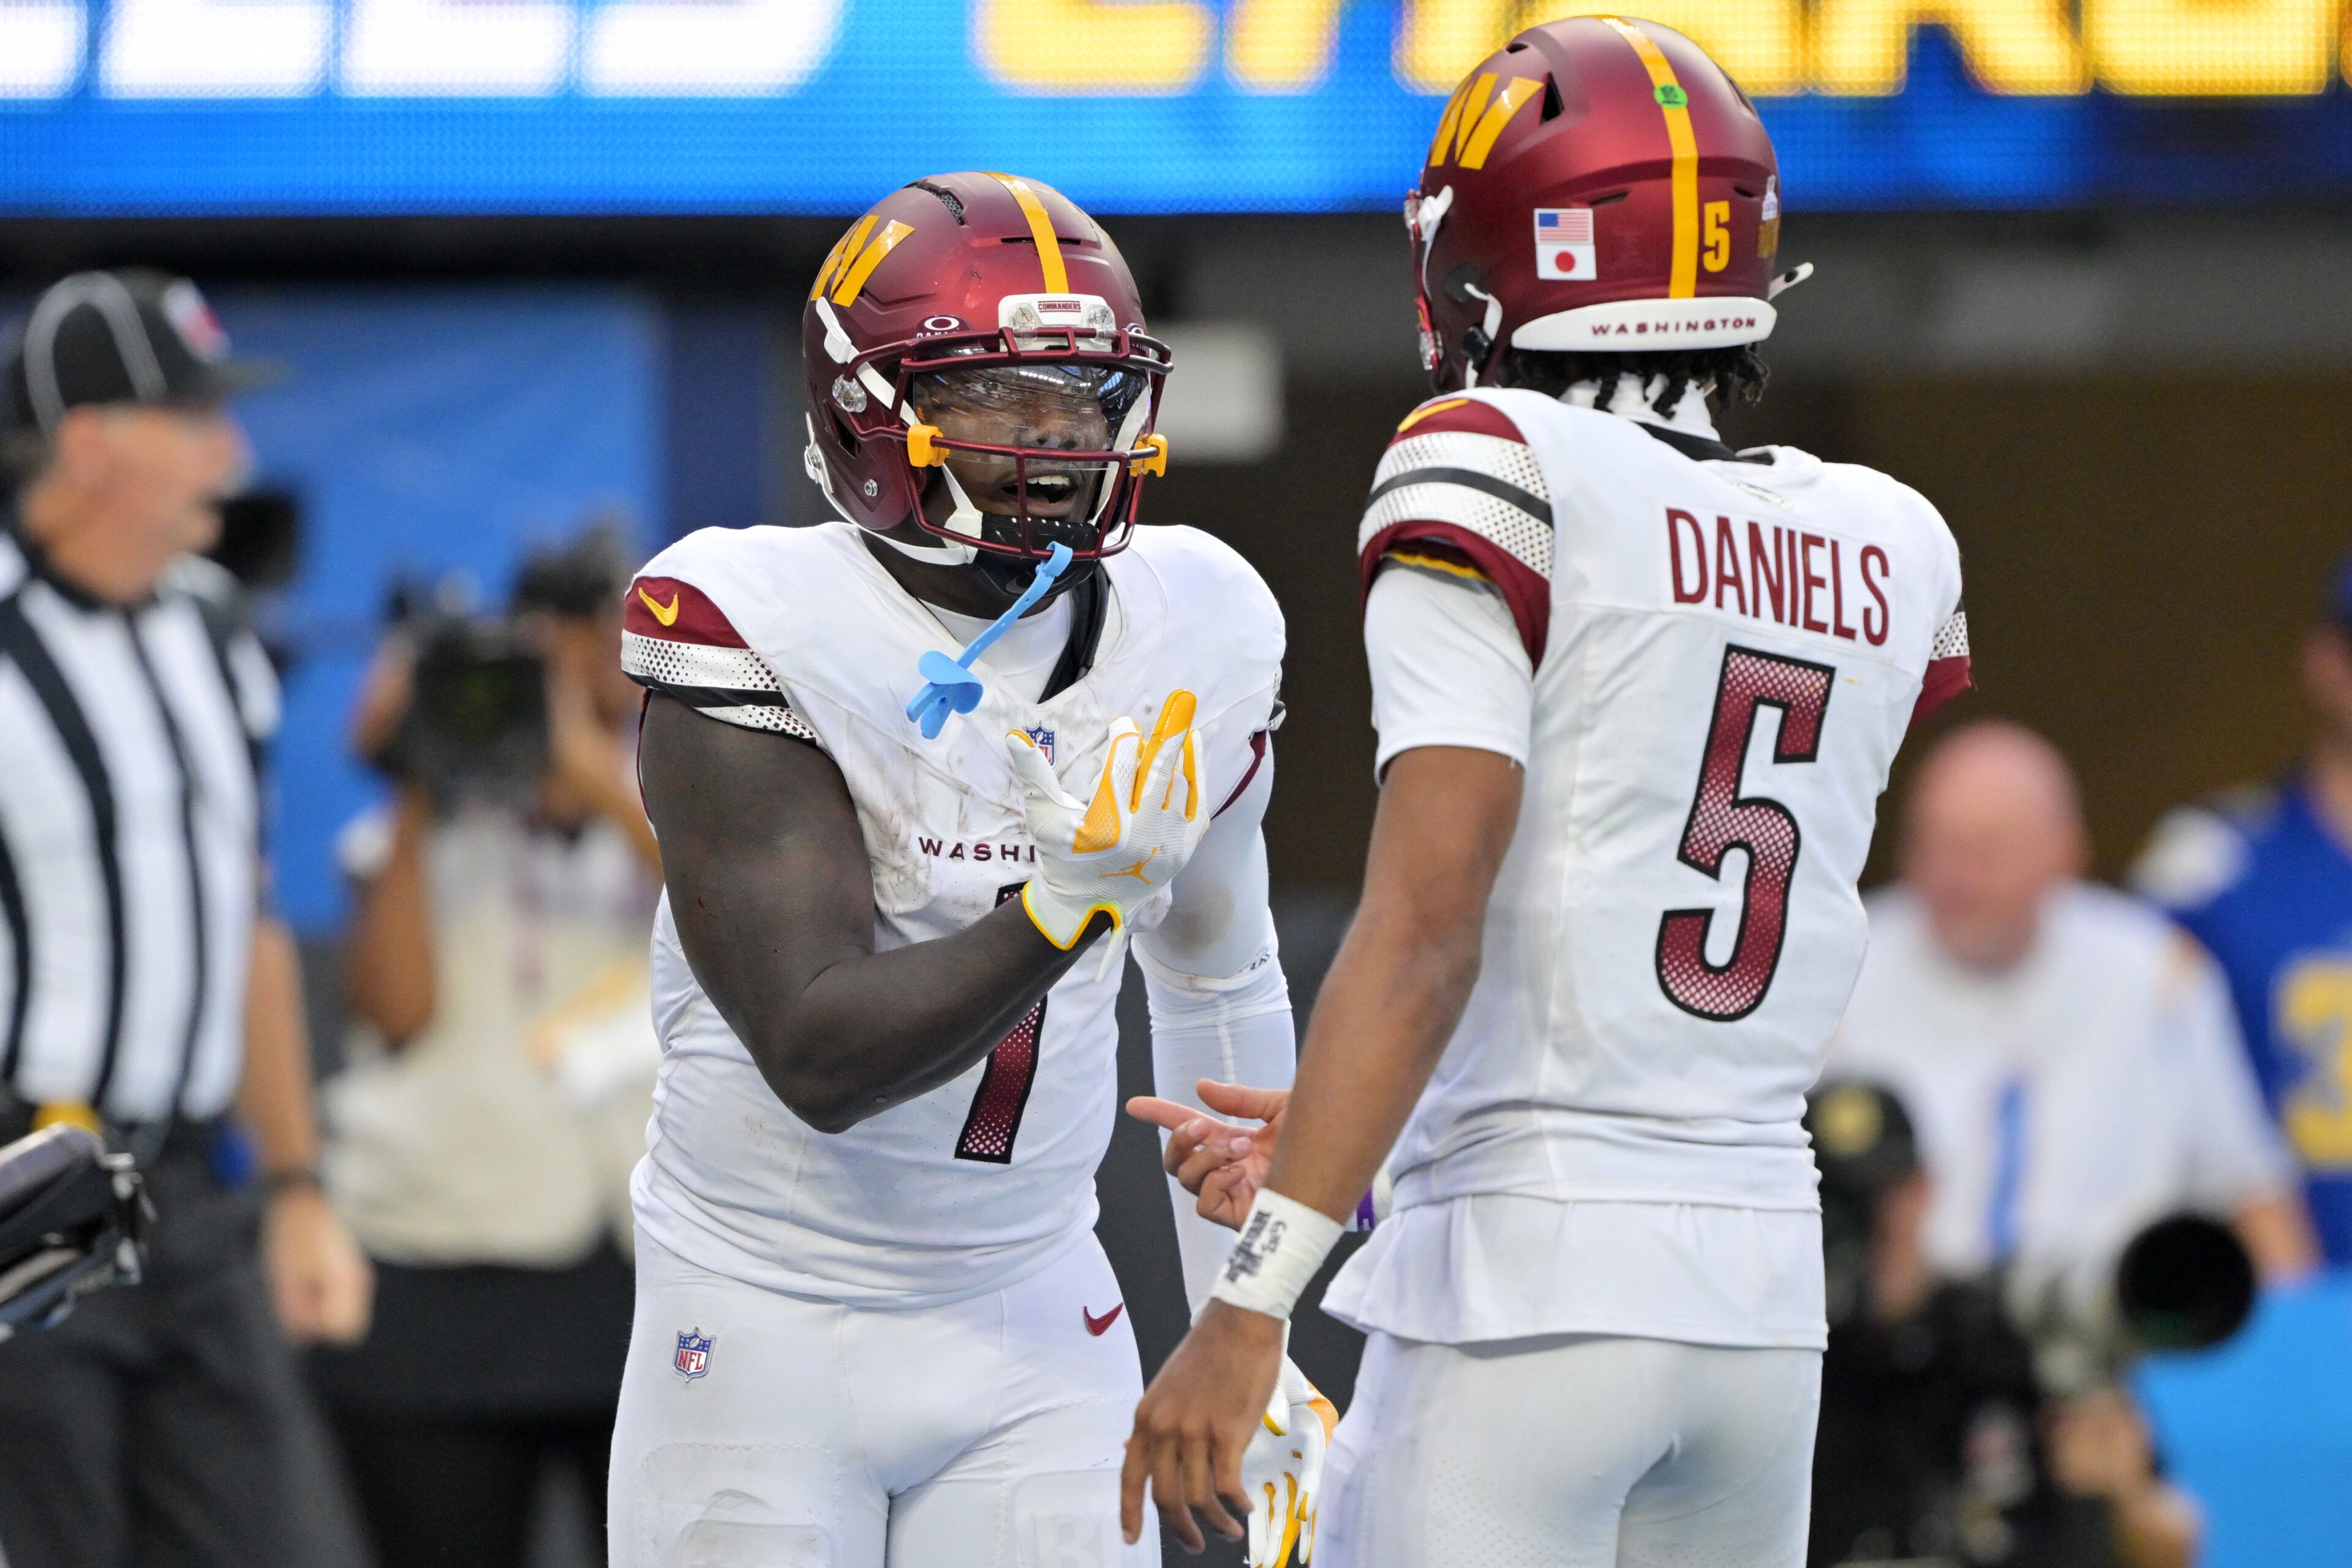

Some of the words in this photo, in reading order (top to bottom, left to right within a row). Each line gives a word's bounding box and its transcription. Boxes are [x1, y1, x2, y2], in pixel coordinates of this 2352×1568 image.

[1703, 200, 1731, 273] 5
[1592, 317, 1755, 335] WASHINGTON
[1665, 507, 1891, 646] DANIELS
[1655, 643, 1836, 1023] 5
[677, 1350, 703, 1372] NFL
